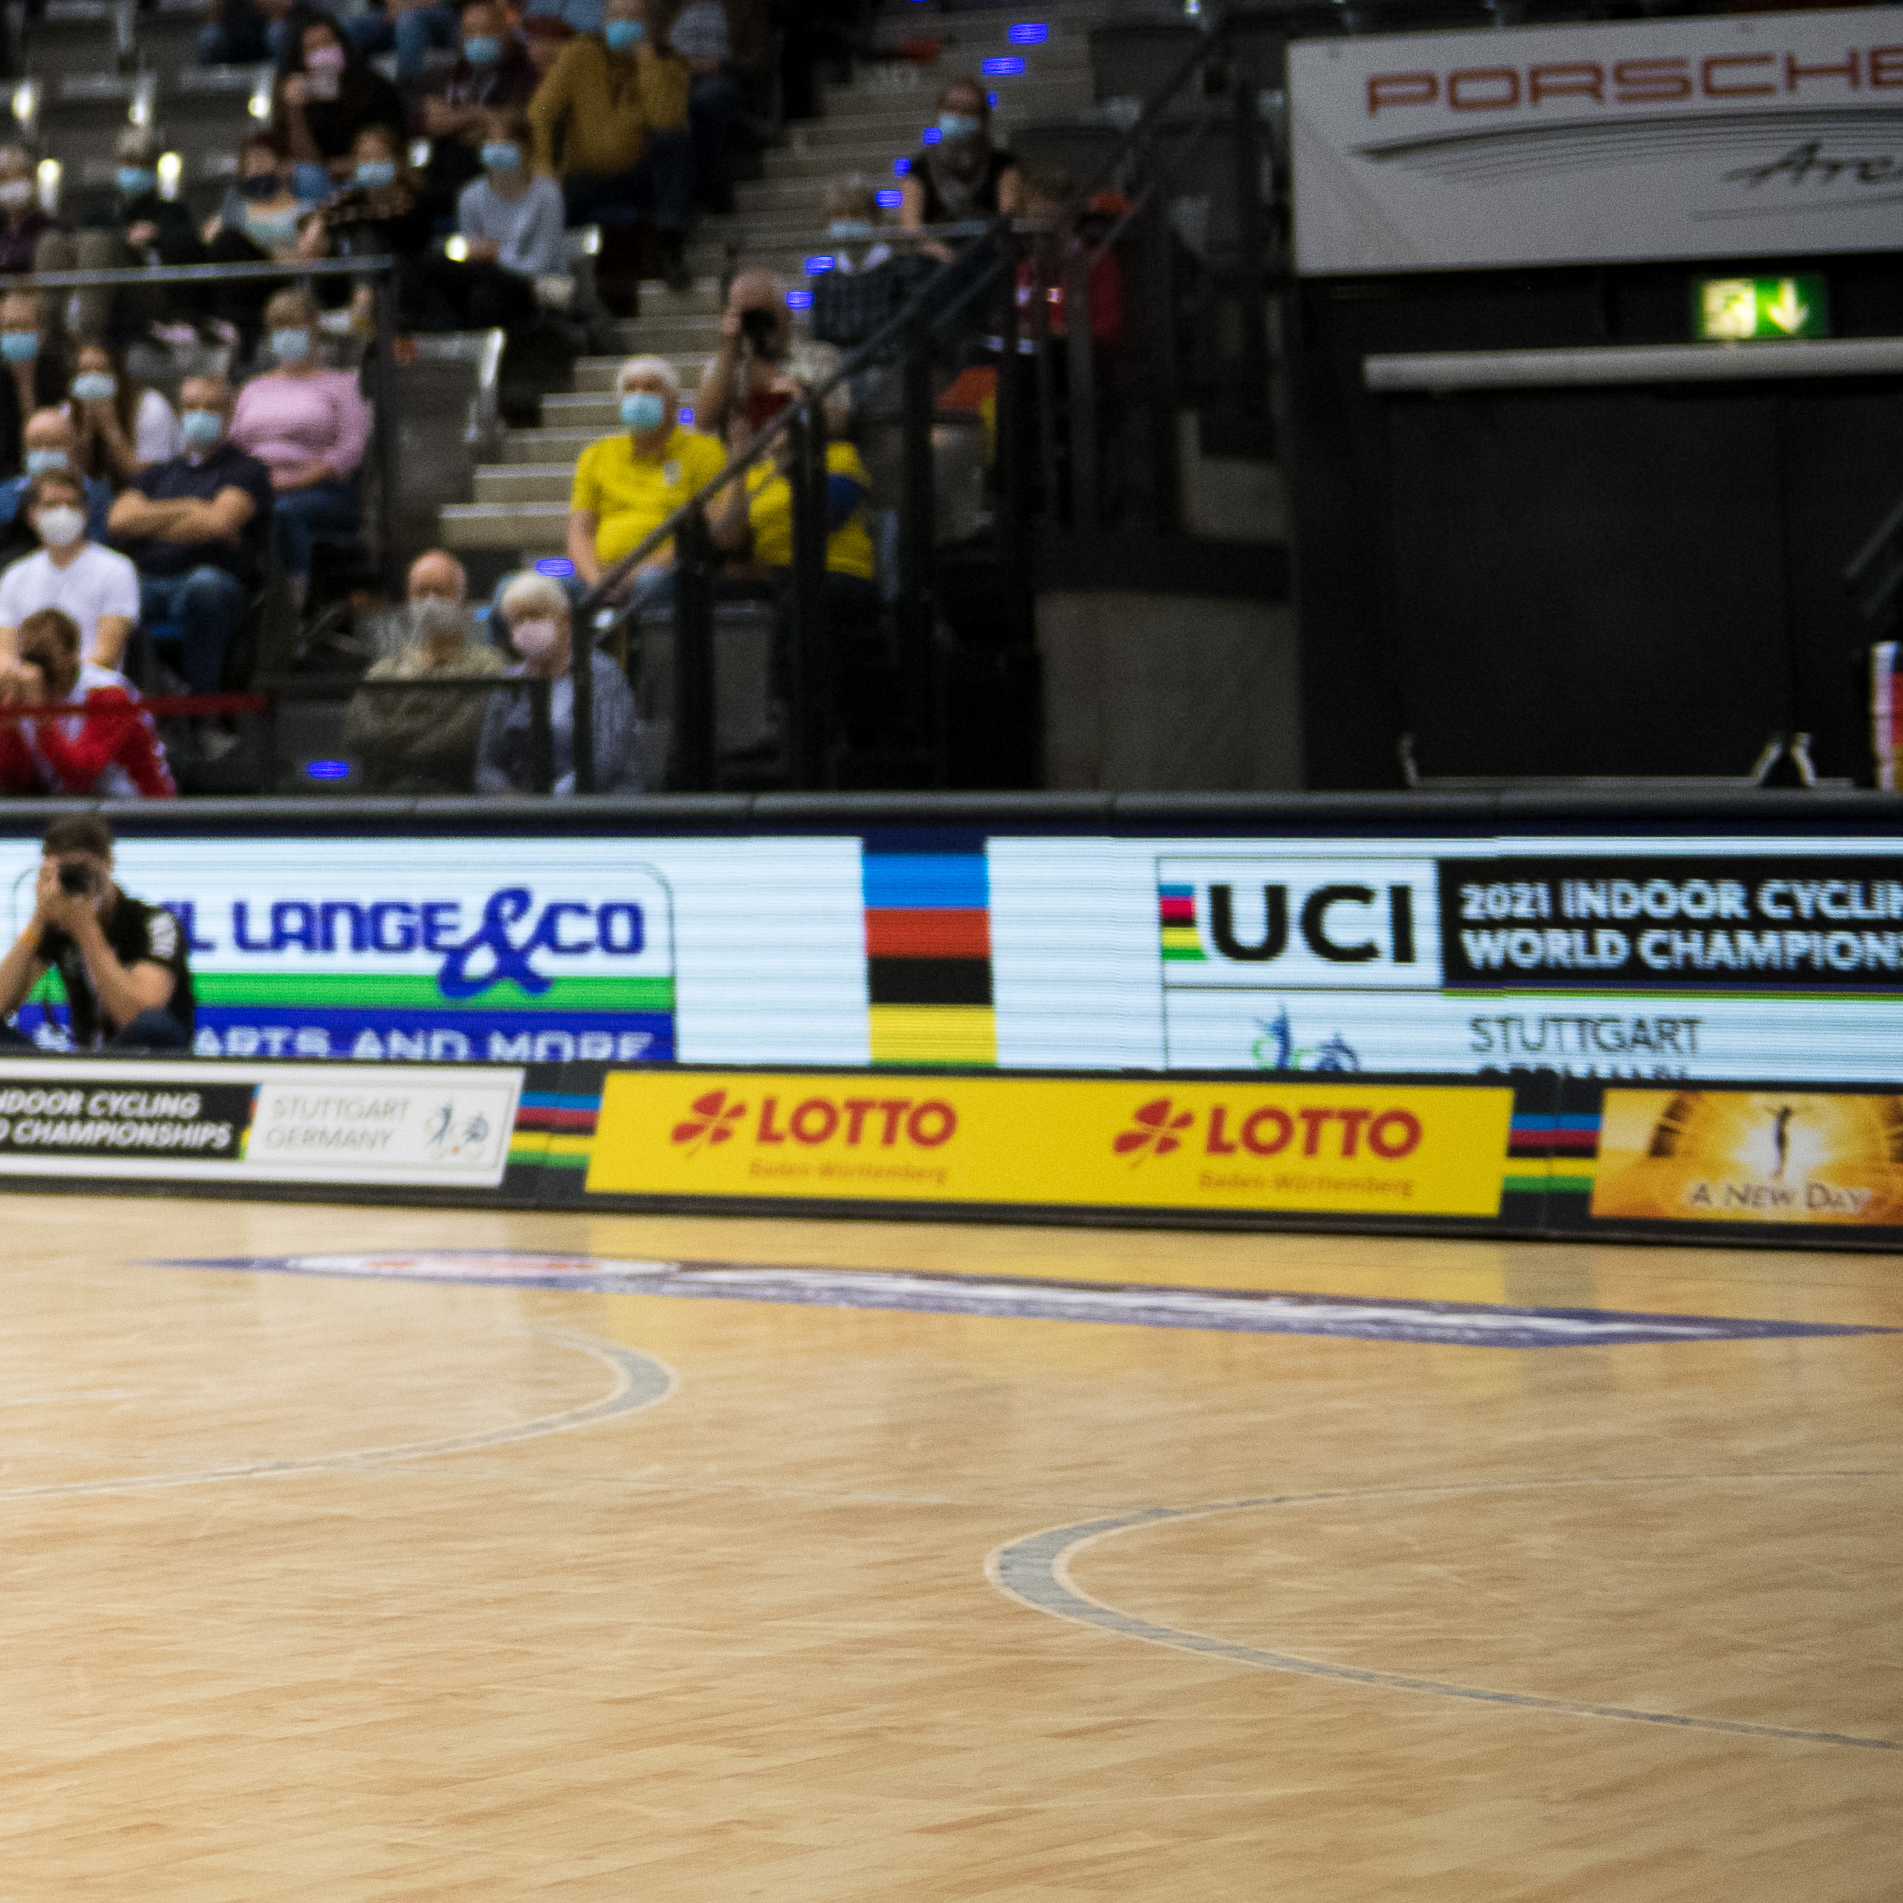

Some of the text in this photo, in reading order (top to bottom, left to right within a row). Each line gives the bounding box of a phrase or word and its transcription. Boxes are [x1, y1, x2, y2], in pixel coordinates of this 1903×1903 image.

[1208, 883, 1416, 964] UCI
[1459, 881, 1552, 920] 2021
[1560, 879, 1751, 920] INDOOR
[232, 886, 646, 999] LANGE&CO
[1459, 928, 1631, 969] WORLD
[1470, 1014, 1705, 1054] STUTTGART
[88, 1092, 201, 1119] CYCLING
[271, 1095, 412, 1123] STUTTGART
[755, 1094, 959, 1149] LOTTO
[11, 1118, 233, 1150] CHAMPIONSHIPS
[264, 1124, 395, 1150] GERMANY
[1204, 1105, 1423, 1161] LOTTO
[1690, 1183, 1713, 1207] A
